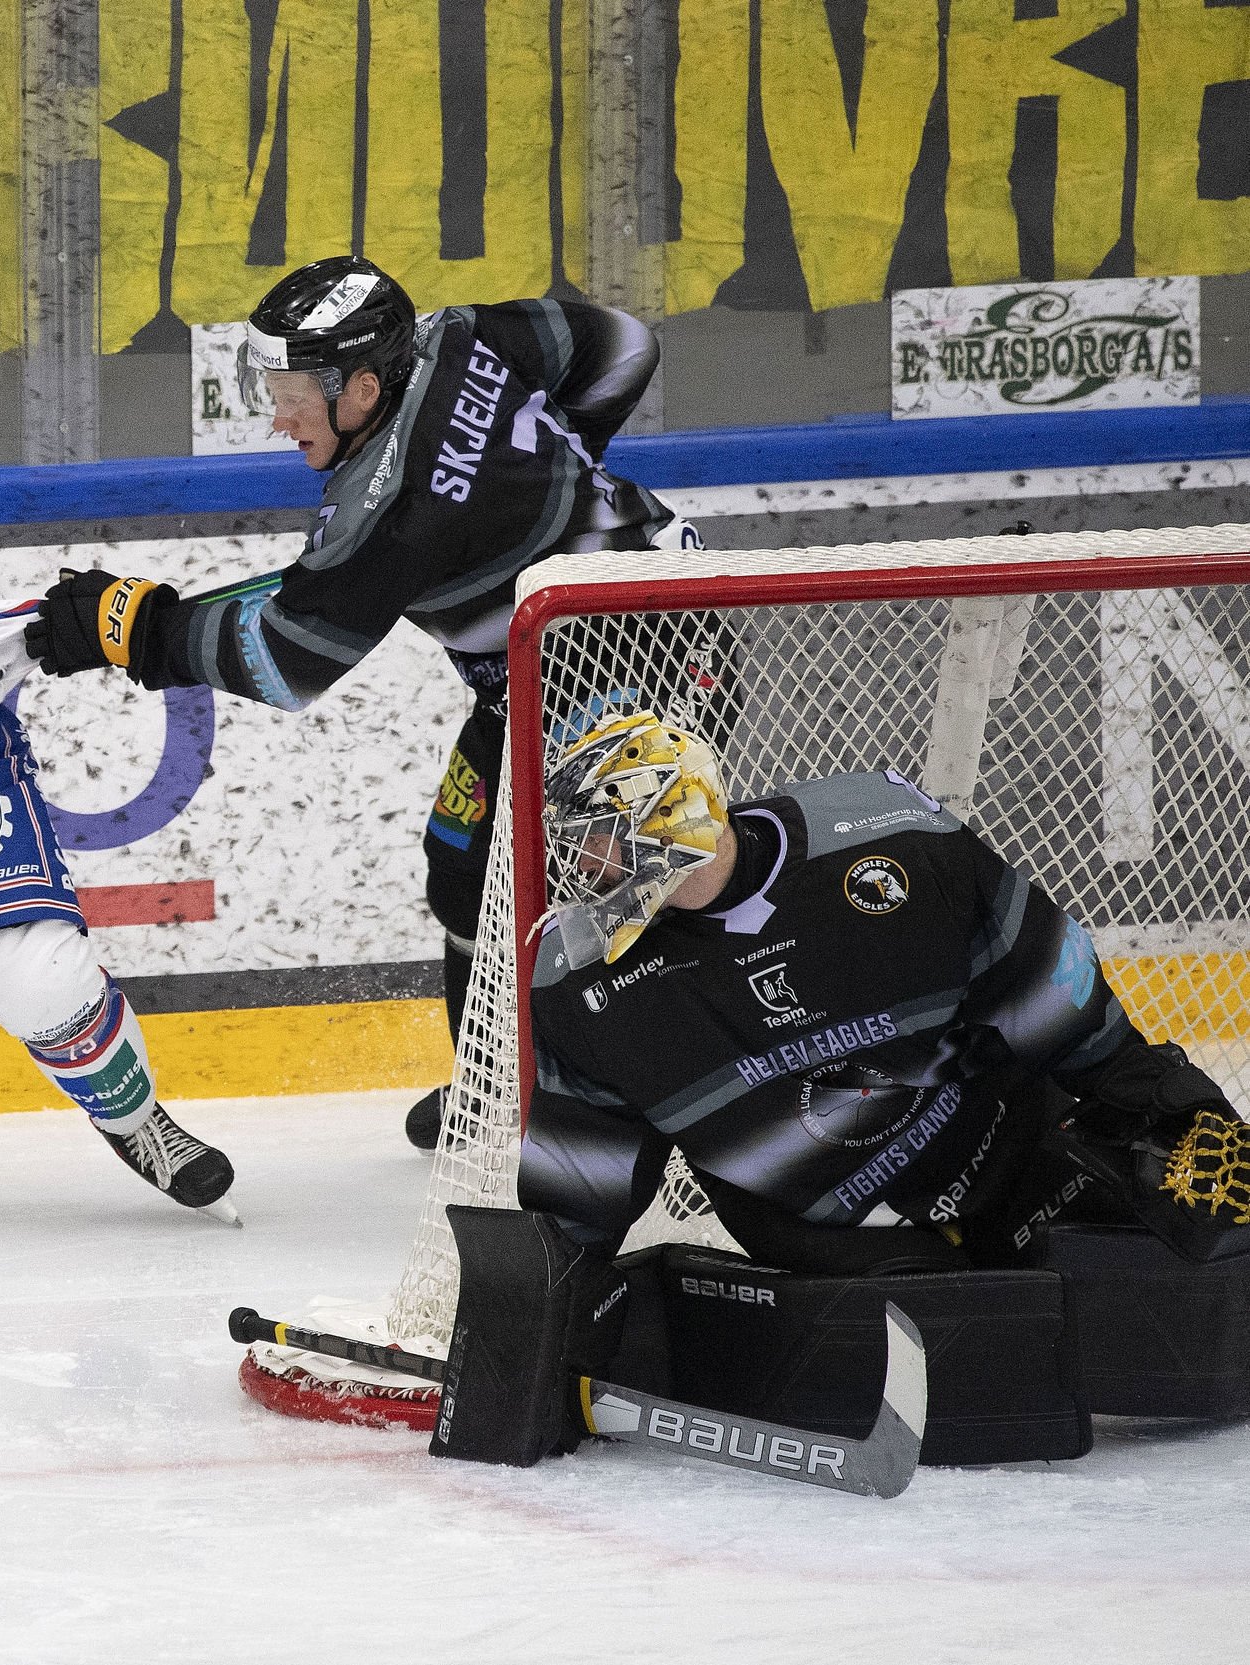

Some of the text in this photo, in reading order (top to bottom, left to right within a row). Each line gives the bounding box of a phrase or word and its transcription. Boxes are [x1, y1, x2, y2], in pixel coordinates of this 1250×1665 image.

[327, 276, 361, 307] TK
[335, 286, 368, 321] MONTAGE
[337, 332, 376, 350] BAUER
[900, 327, 1193, 386] E. TRASBORG A/S
[853, 818, 868, 828] LH
[868, 808, 912, 824] Hockerup
[851, 860, 891, 879] HERLEV
[606, 890, 652, 938] BAUER
[851, 892, 891, 911] EAGLES
[745, 938, 797, 964] BAUER
[612, 955, 665, 992] Herlev
[657, 958, 700, 978] Kommune
[762, 1005, 807, 1030] Team
[793, 1009, 828, 1028] Herlev
[811, 1012, 898, 1060] EAGLES
[844, 1139, 863, 1148] YOU
[864, 1128, 891, 1146] CAN'T
[890, 1113, 911, 1133] BEAT
[834, 1141, 911, 1212] FIGHTS
[592, 1281, 629, 1323] MACH
[680, 1276, 777, 1307] BAUER
[647, 1405, 847, 1481] BAUER
